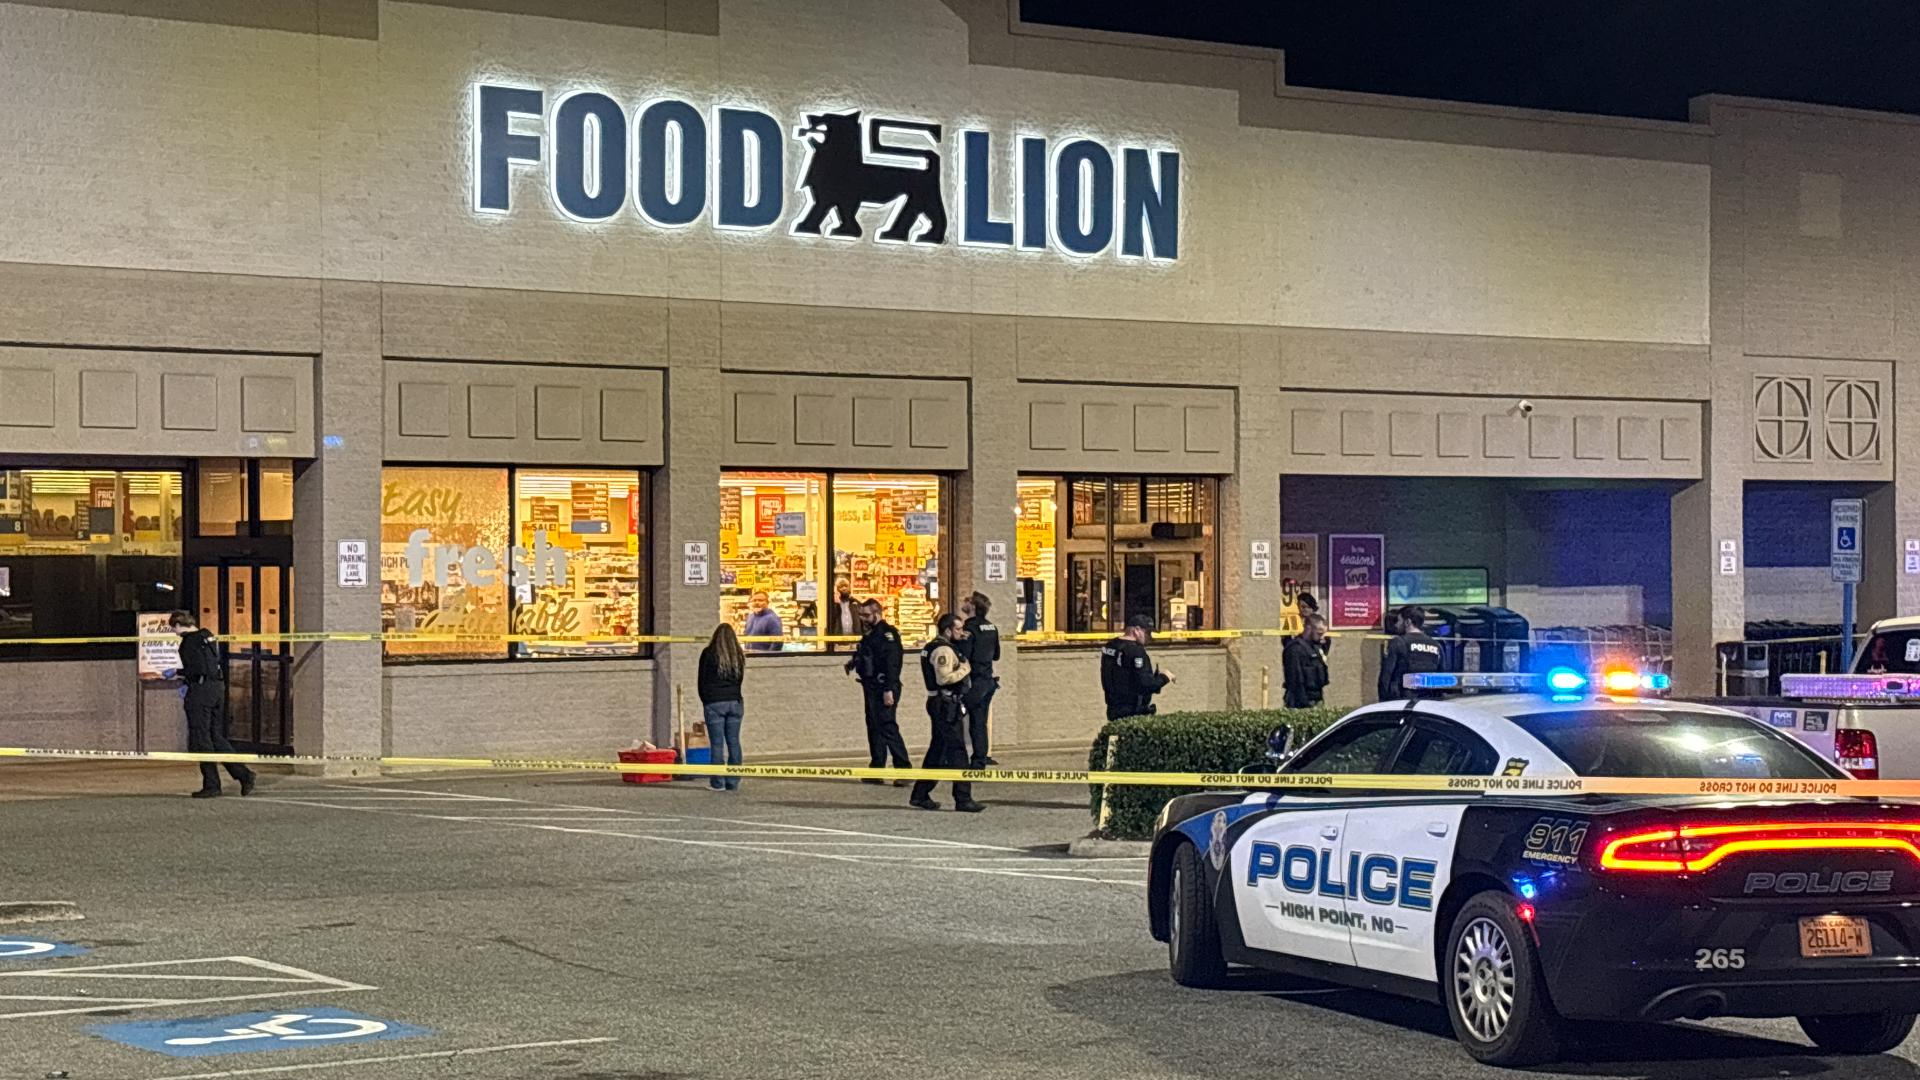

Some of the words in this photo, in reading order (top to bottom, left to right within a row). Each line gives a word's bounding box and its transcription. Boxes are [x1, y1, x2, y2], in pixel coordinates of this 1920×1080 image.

[475, 82, 783, 230] FOOD
[958, 129, 1179, 260] LION
[383, 482, 461, 523] Easy
[906, 519, 913, 530] 6
[1835, 514, 1859, 523] PARKING
[14, 520, 22, 532] 8
[600, 523, 609, 532] 5
[347, 543, 359, 554] NO
[690, 545, 701, 554] NO
[721, 542, 731, 555] 5
[991, 545, 1001, 553] NO
[1256, 543, 1265, 552] NO
[340, 554, 366, 564] PARKING
[404, 528, 568, 588] fresh
[685, 554, 707, 563] PARKING
[986, 553, 1006, 561] PARKING
[1346, 572, 1368, 586] MVP
[1526, 823, 1588, 855] 911
[1522, 850, 1579, 865] EMERGENCY
[1247, 839, 1438, 912] POLICE
[1743, 870, 1894, 894] POLICE
[1280, 901, 1315, 921] HIGH
[1319, 907, 1367, 931] POINT,
[1806, 927, 1863, 949] 26114-W
[1694, 948, 1746, 970] 265
